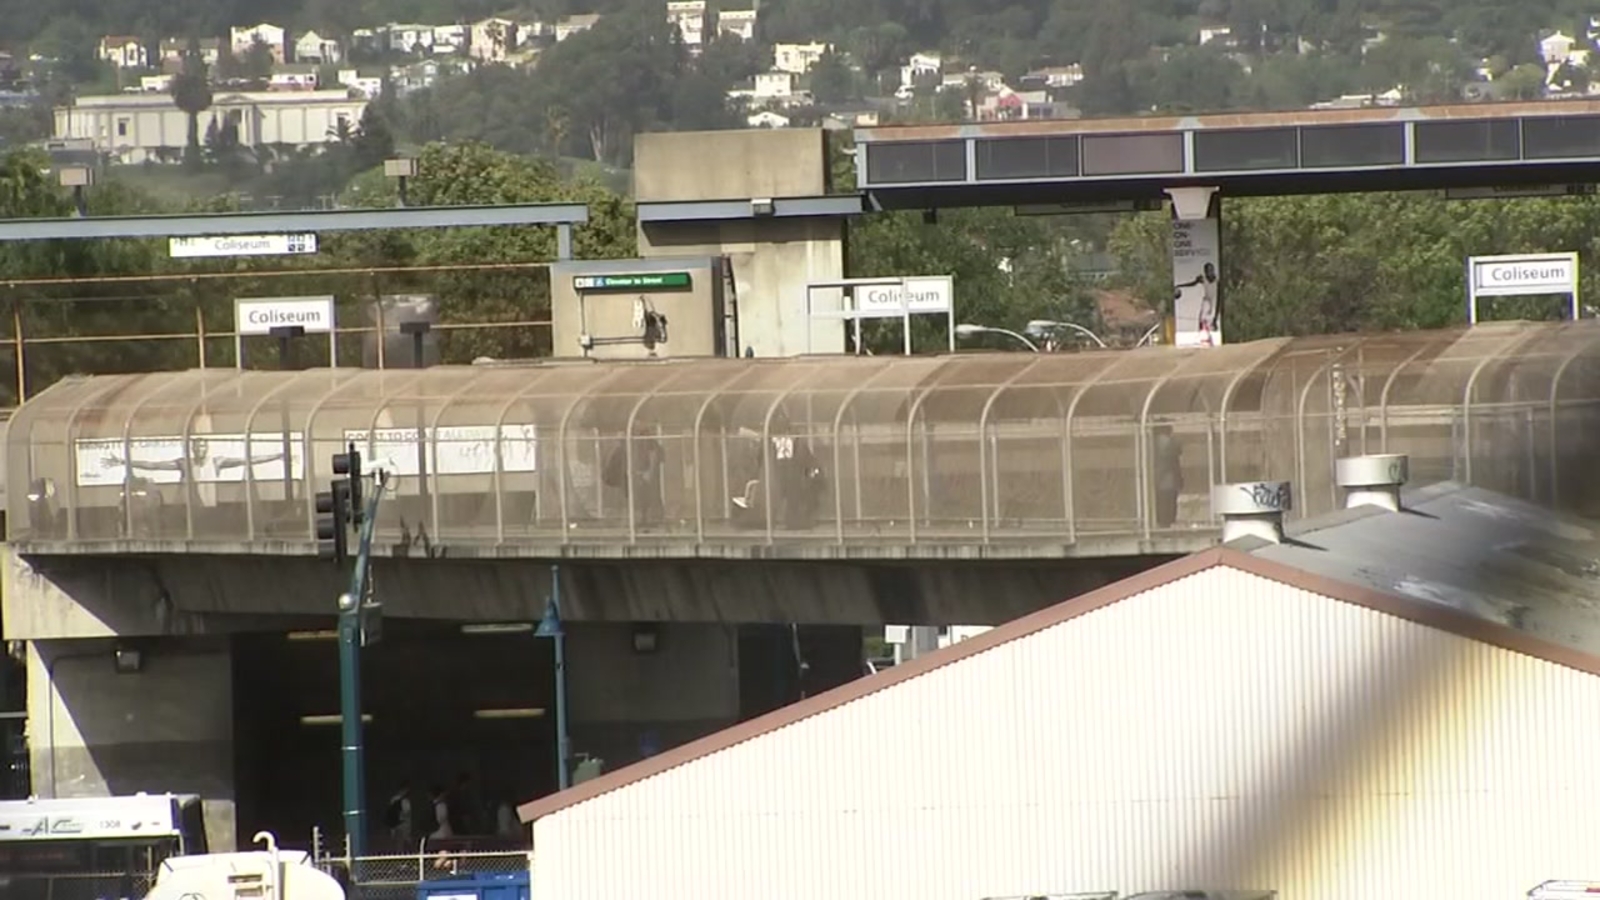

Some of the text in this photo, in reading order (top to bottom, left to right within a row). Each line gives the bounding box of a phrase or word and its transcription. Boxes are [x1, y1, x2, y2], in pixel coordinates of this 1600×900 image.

[214, 239, 271, 251] Coliseum
[1491, 266, 1565, 281] Coliseum
[868, 289, 940, 304] Colieum
[249, 310, 321, 324] Coliseum
